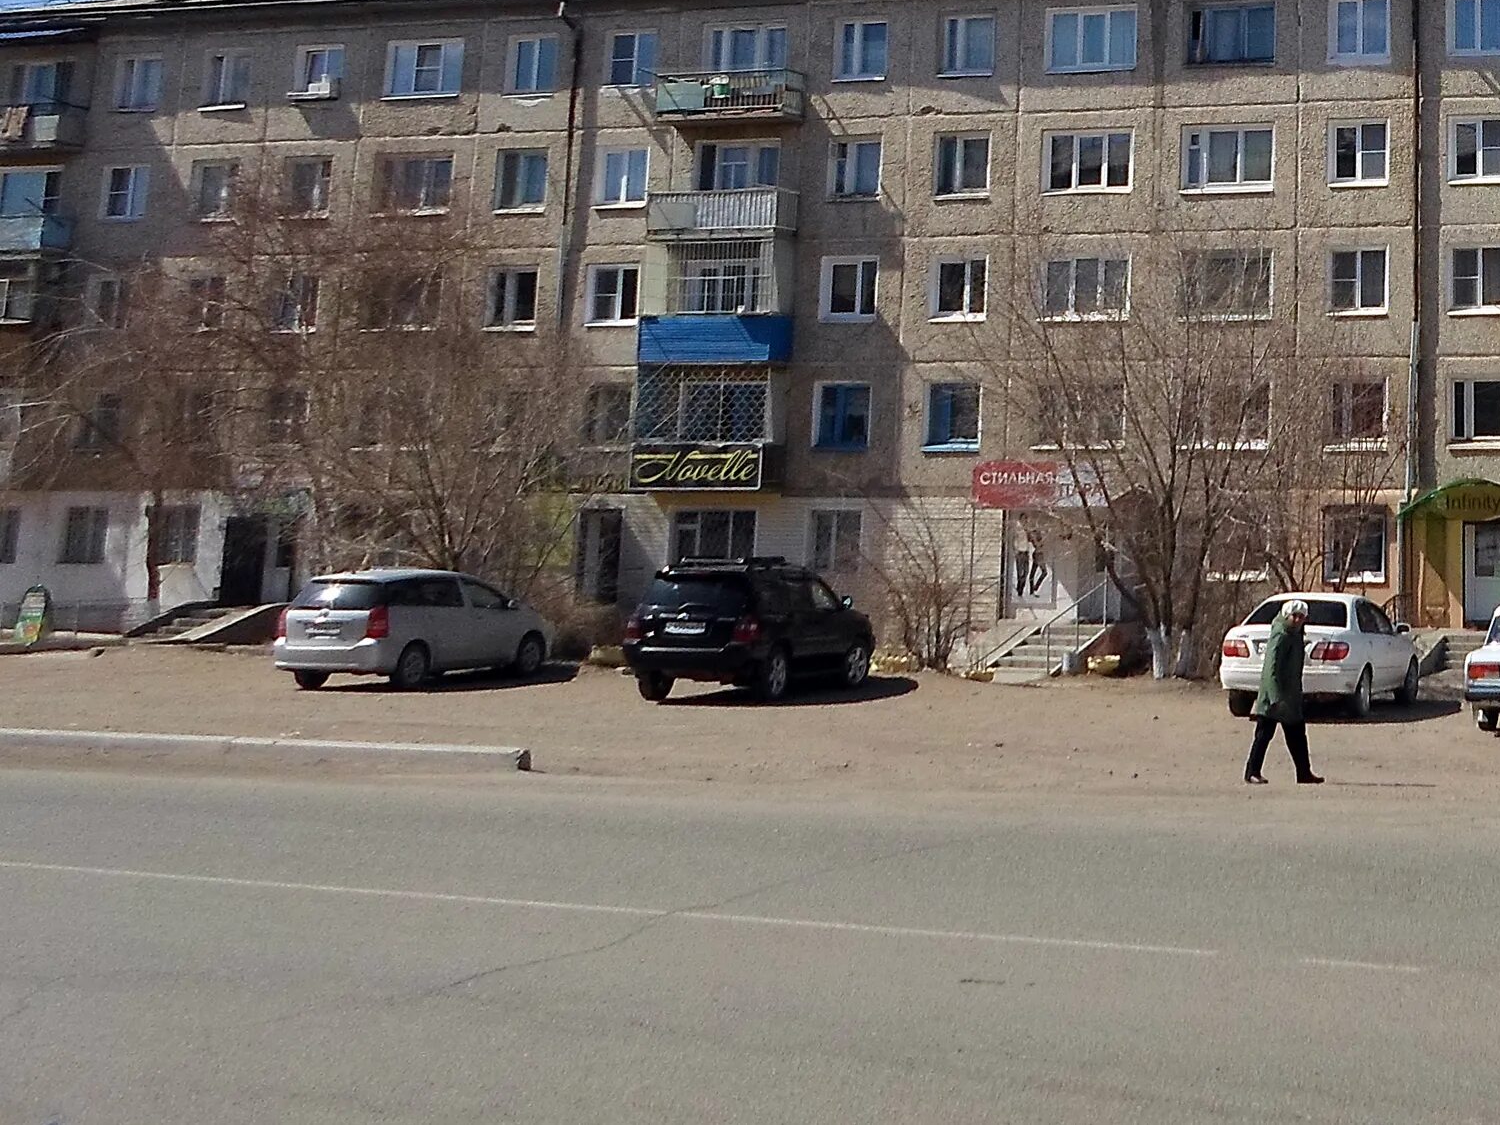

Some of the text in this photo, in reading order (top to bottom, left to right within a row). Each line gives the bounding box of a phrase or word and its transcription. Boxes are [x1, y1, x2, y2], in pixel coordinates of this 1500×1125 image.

[635, 449, 758, 482] Novelle
[980, 471, 1053, 486] СТИЛЬНАЯ
[1446, 495, 1500, 515] Infinity
